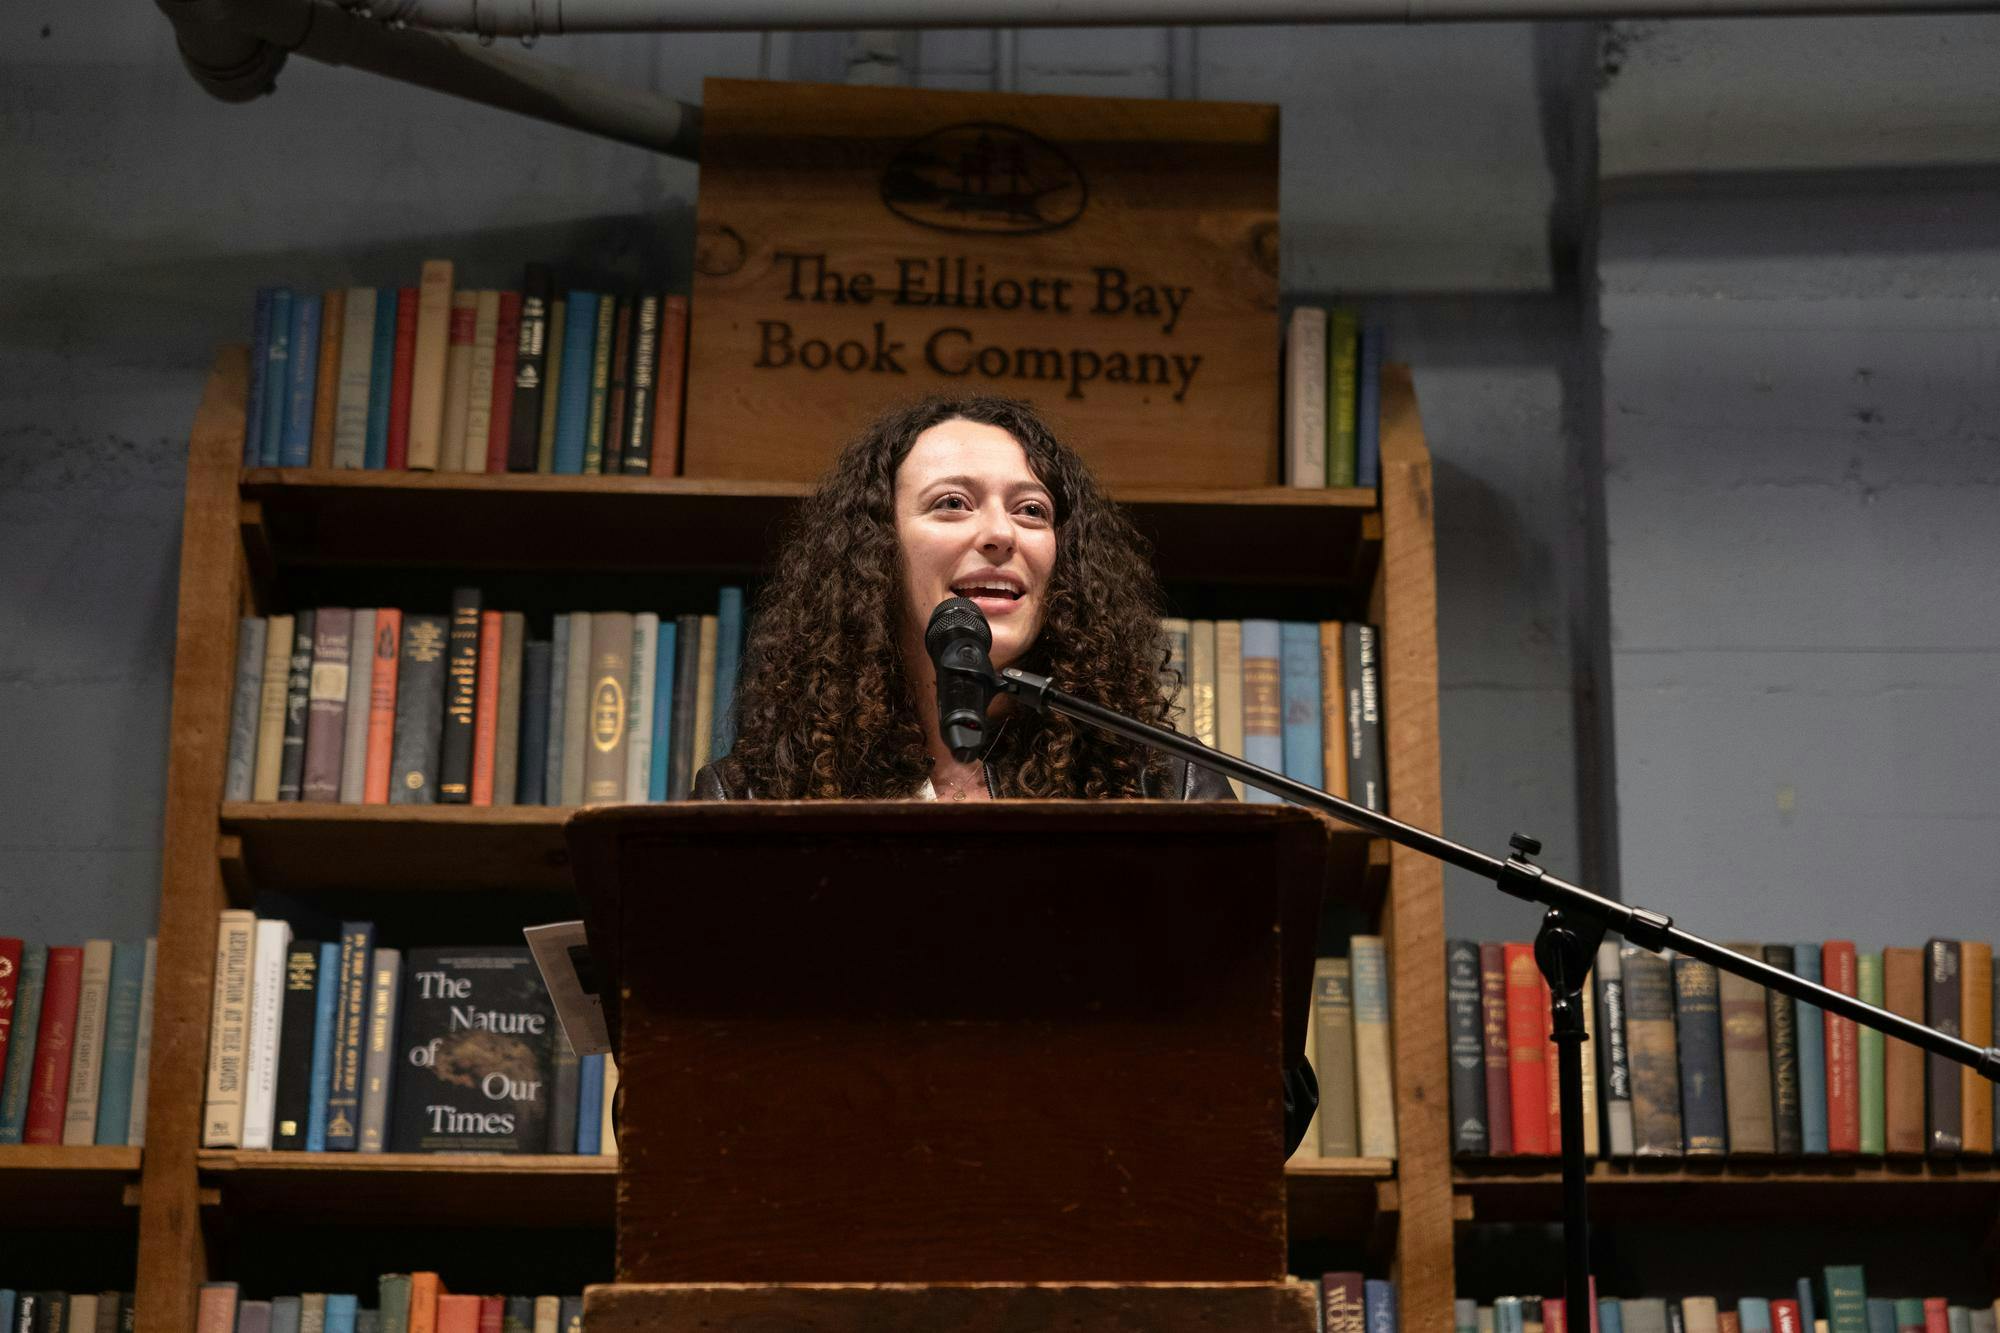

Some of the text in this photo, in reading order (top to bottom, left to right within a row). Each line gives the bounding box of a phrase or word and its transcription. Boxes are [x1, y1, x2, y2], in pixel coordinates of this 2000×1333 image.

[773, 252, 1194, 334] The Elliott Bay
[753, 320, 1205, 402] Book Company
[225, 930, 248, 1003] REVOLUTION
[415, 971, 472, 999] The
[450, 1006, 546, 1035] Nature
[222, 1026, 242, 1052] THE
[408, 1038, 444, 1067] of
[481, 1072, 542, 1102] Our
[426, 1105, 515, 1135] Times
